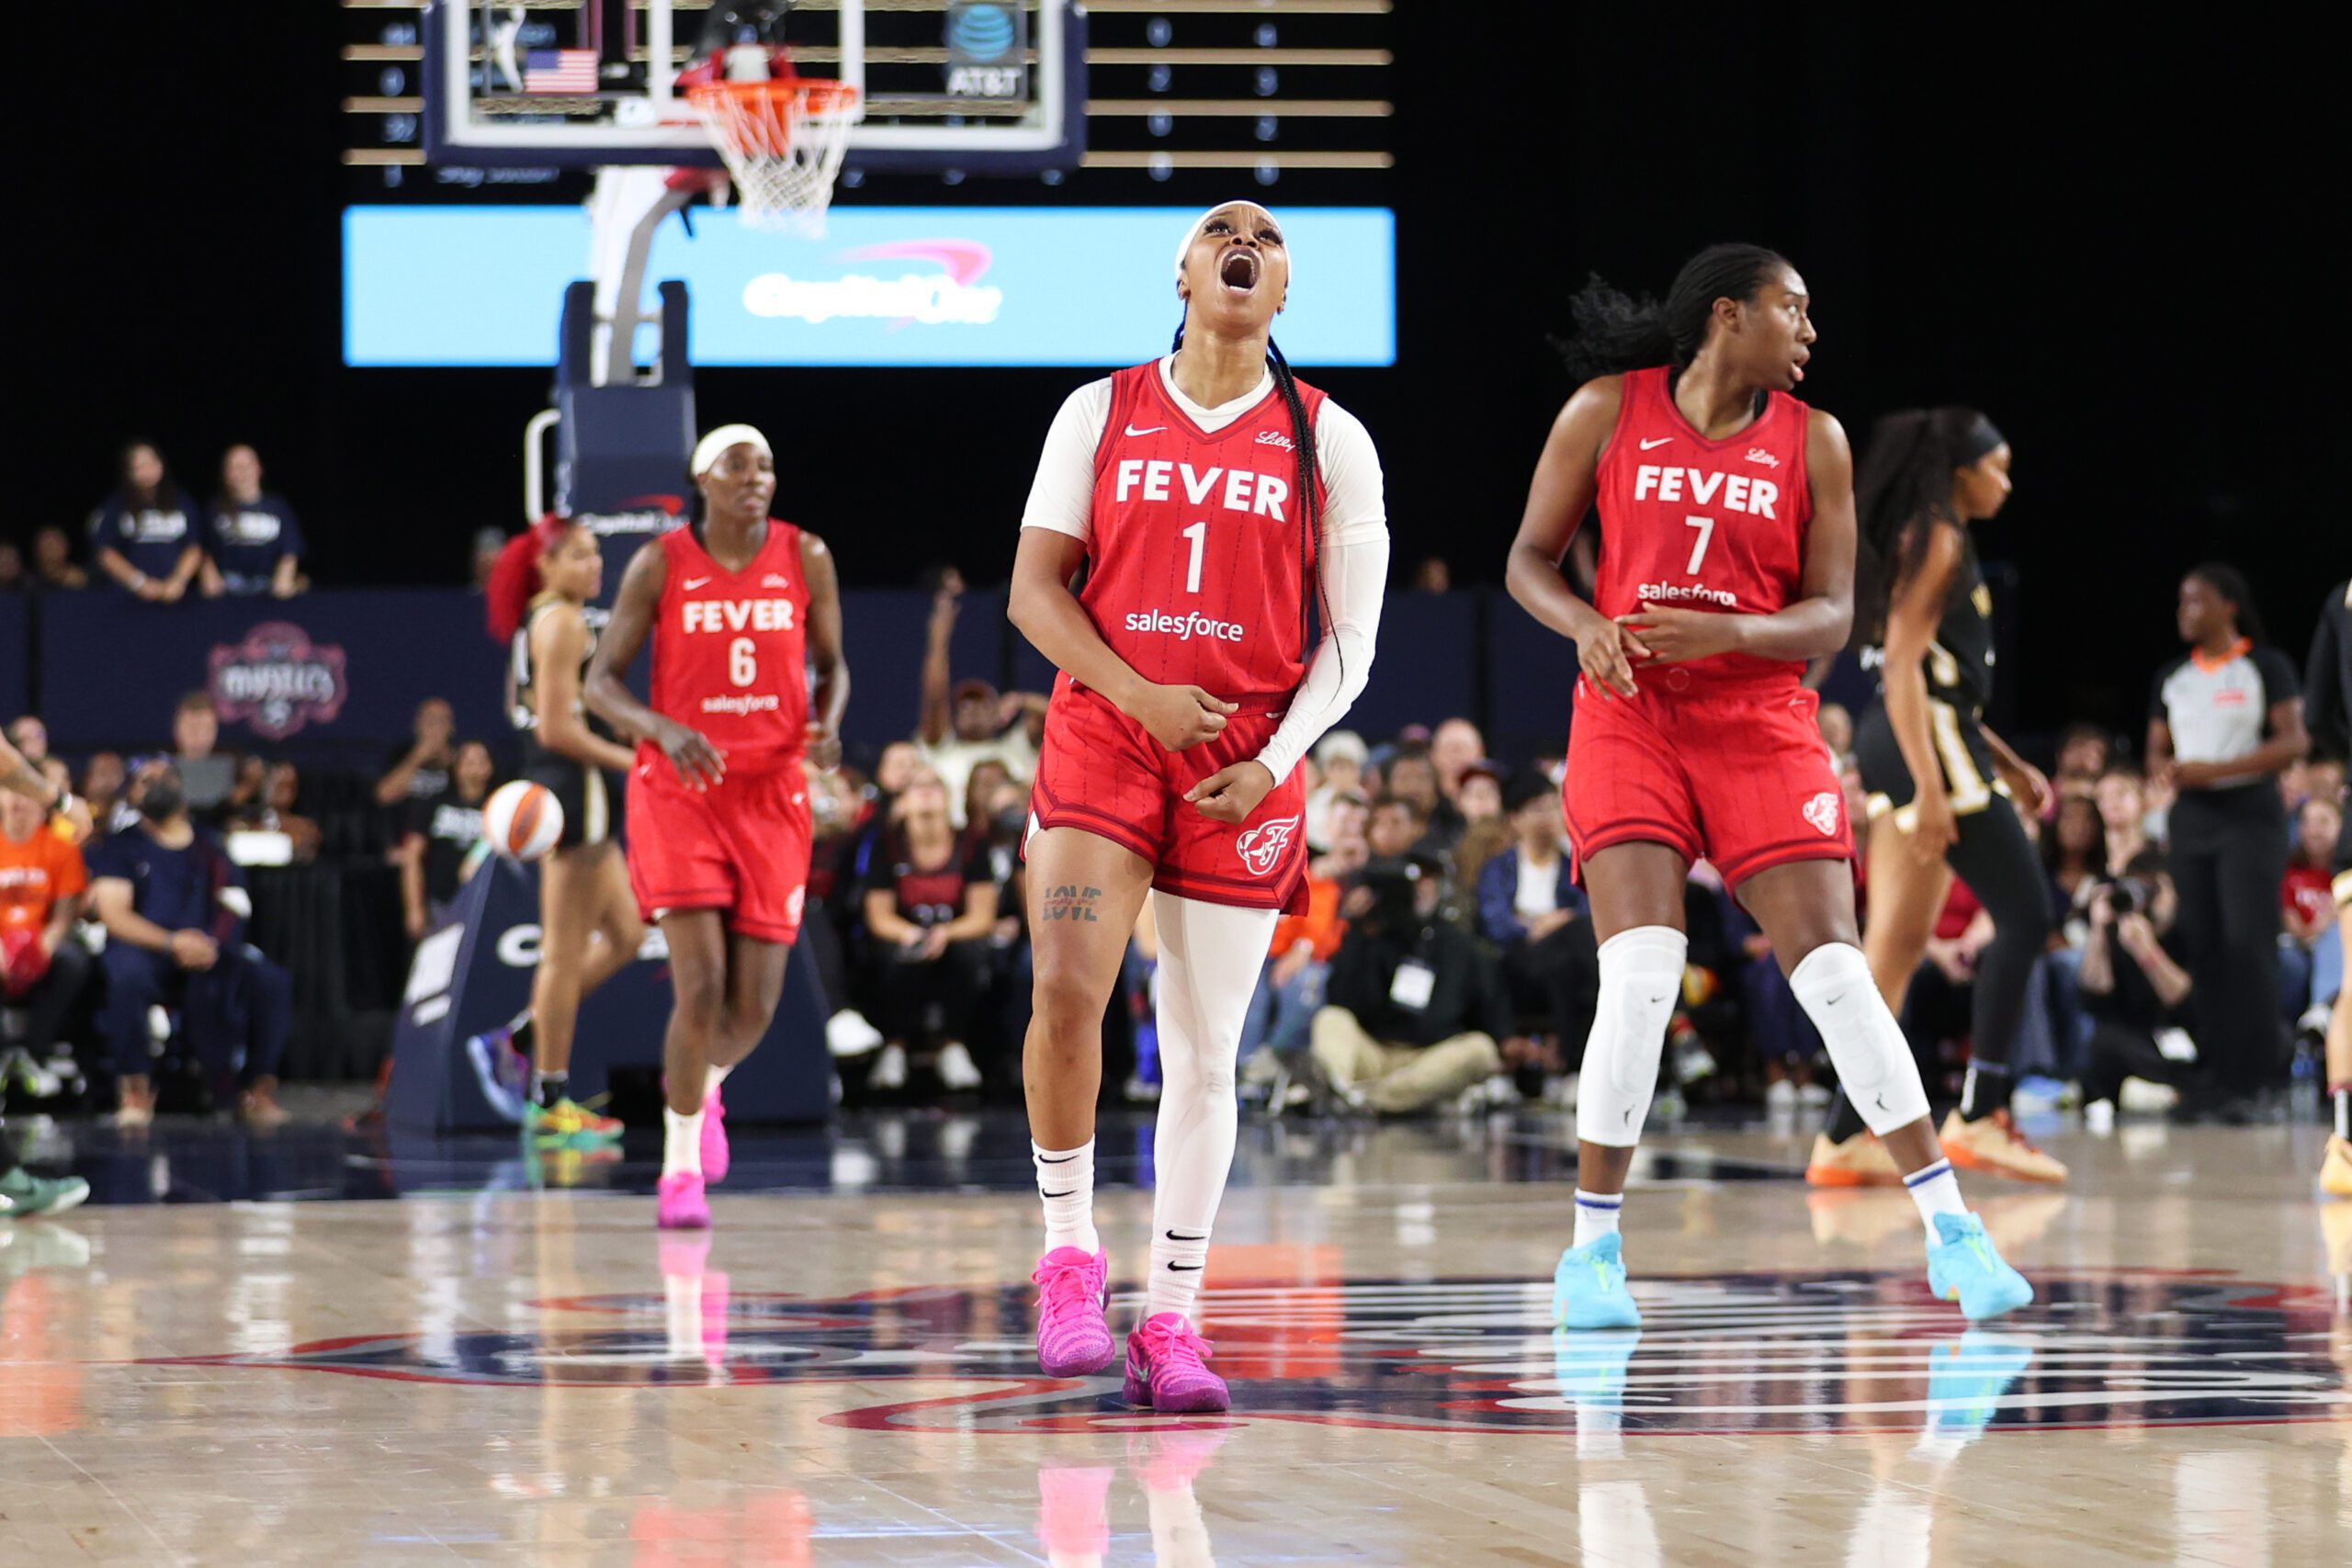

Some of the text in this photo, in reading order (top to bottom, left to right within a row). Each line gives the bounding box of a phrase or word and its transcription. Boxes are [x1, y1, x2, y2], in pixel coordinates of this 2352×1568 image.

[1254, 431, 1295, 453] Lilly
[1116, 459, 1289, 522] FEVER
[1634, 464, 1779, 520] FEVER
[1182, 522, 1206, 593] 1
[1685, 515, 1714, 575] 7
[683, 599, 794, 634] FEVER
[1125, 610, 1244, 640] salesforce
[729, 637, 757, 687] 6
